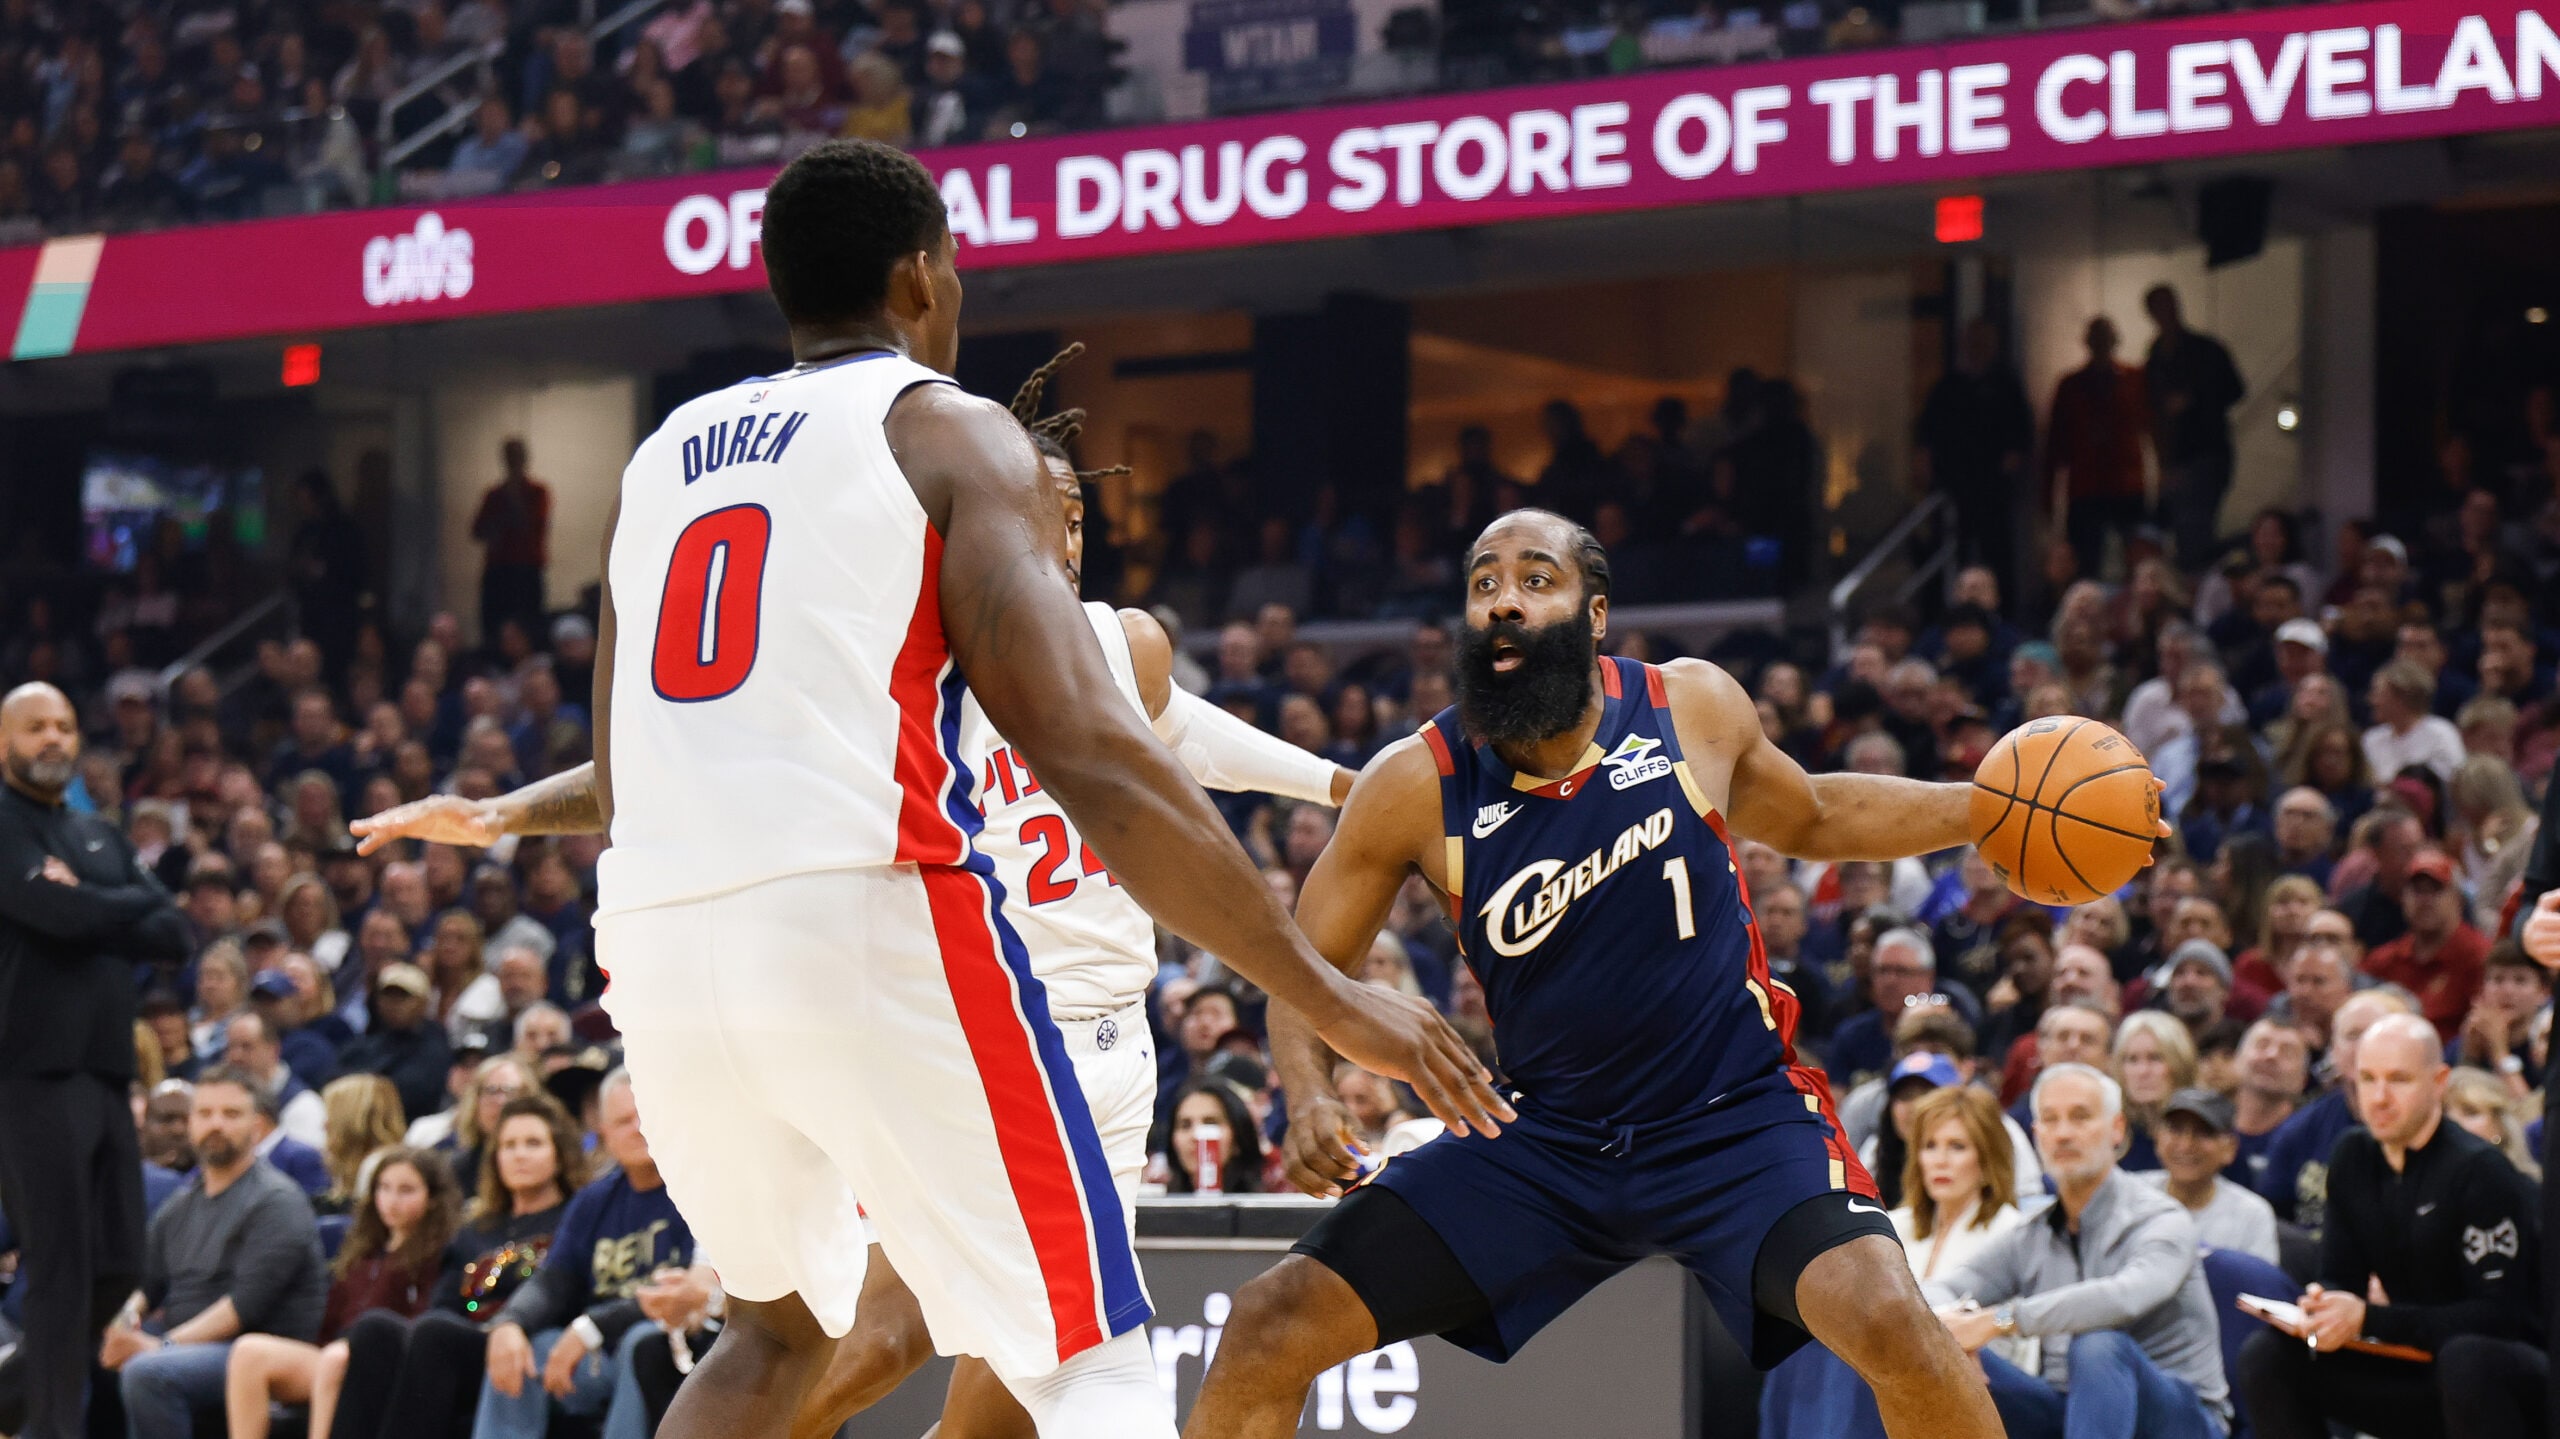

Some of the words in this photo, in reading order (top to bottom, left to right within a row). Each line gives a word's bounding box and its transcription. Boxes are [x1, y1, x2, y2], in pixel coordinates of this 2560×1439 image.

[1056, 135, 1308, 239] DRUG
[1328, 100, 1632, 213] STORE
[1652, 84, 1791, 180] OF
[1808, 62, 2010, 165] THE
[682, 411, 809, 486] DUREN
[651, 503, 772, 703] 0
[1478, 801, 1509, 826] NIKE
[1613, 759, 1669, 786] CLIFFS
[1477, 807, 1674, 957] CLEVELAND
[1662, 856, 1696, 941] 1
